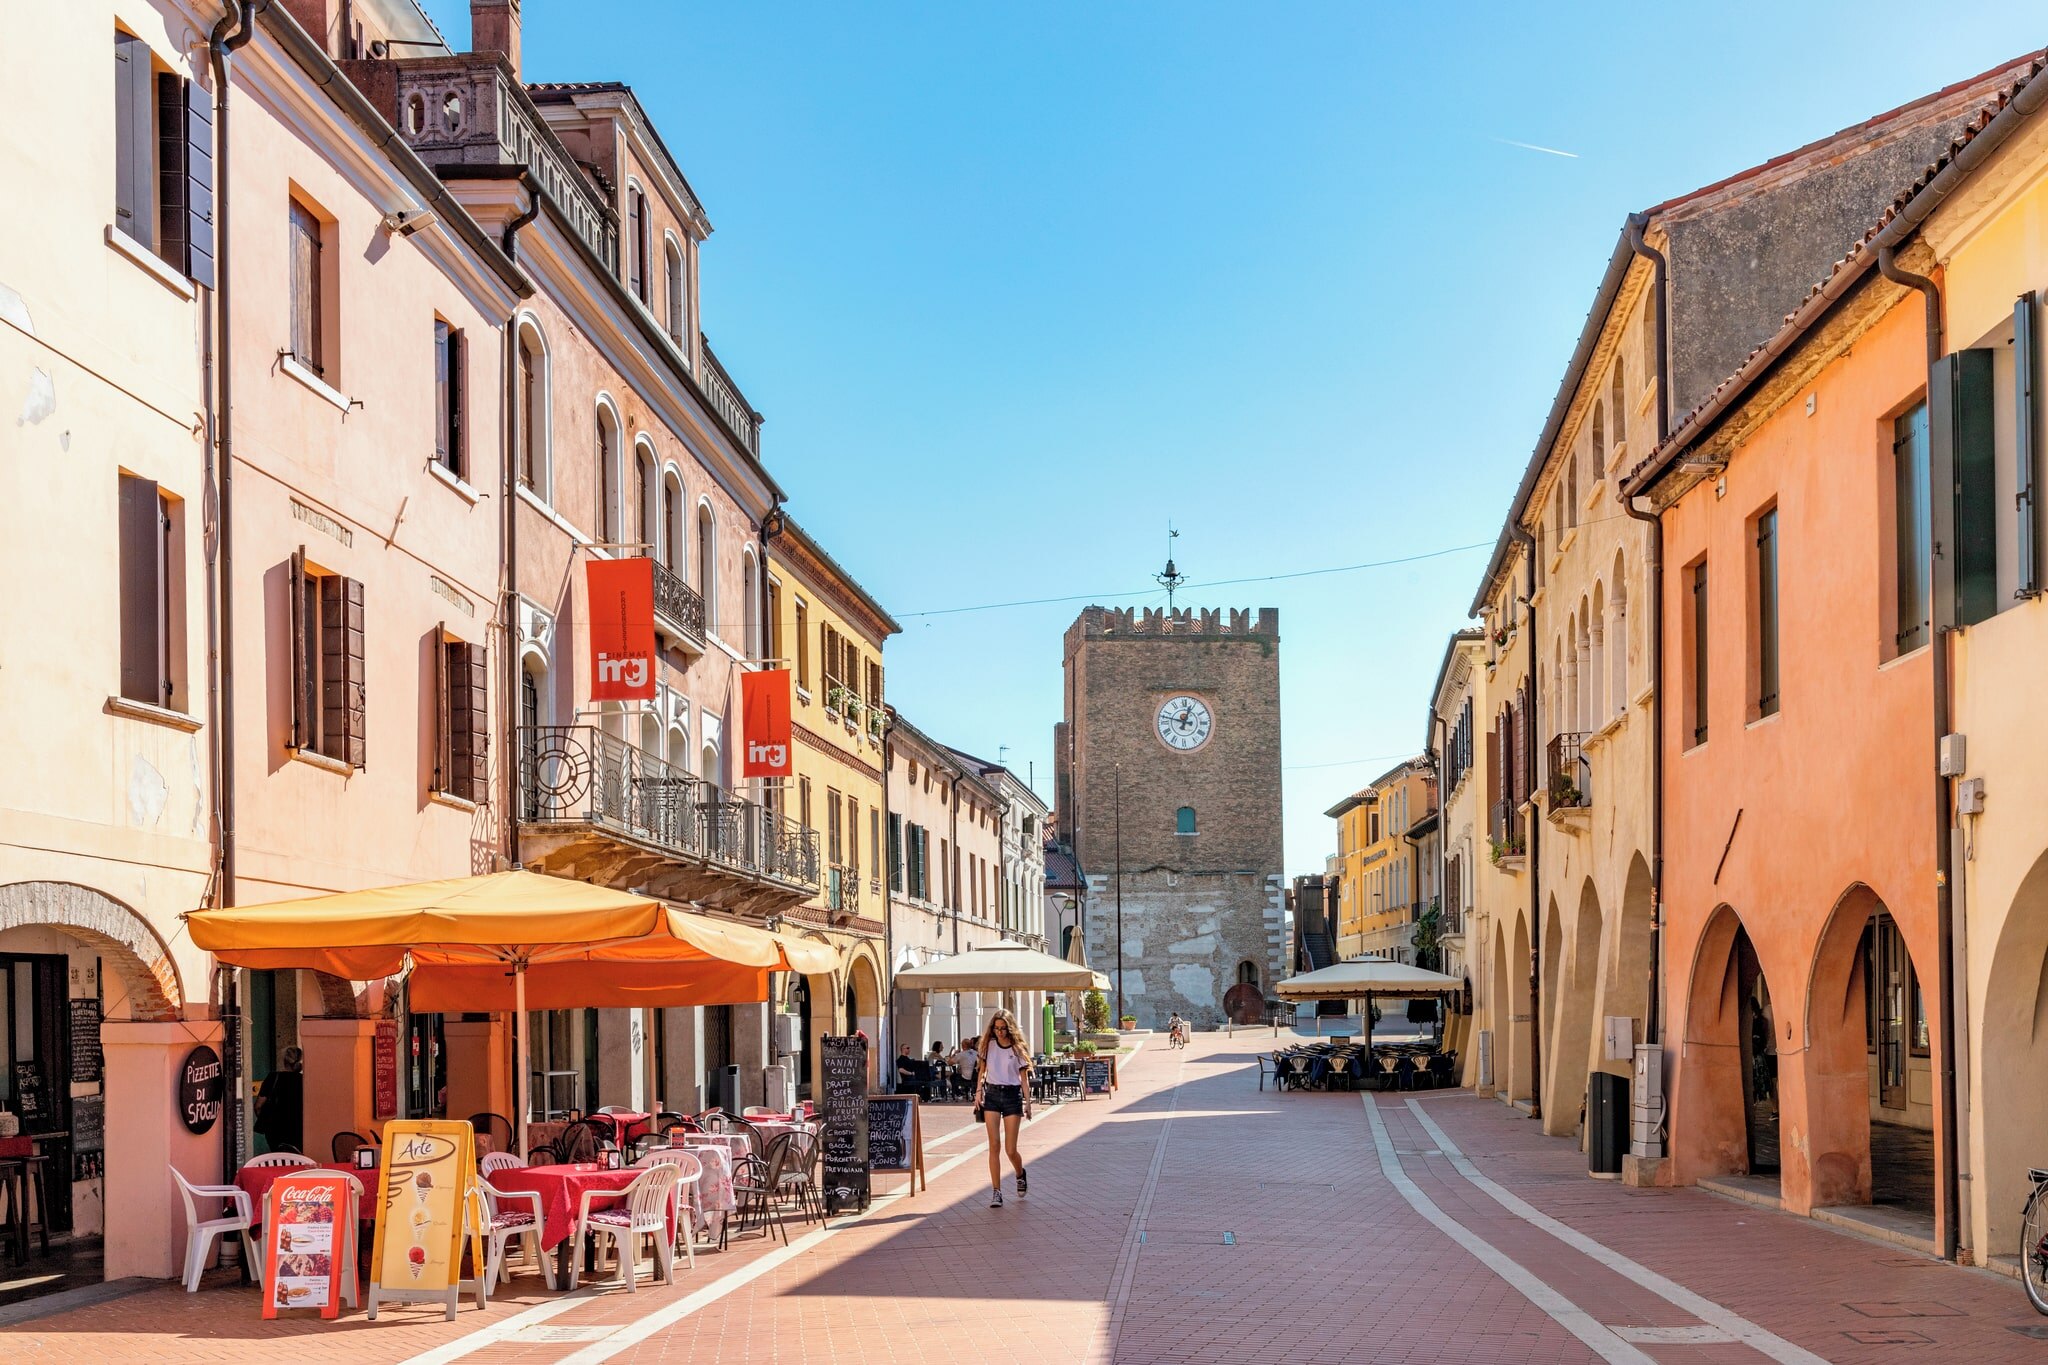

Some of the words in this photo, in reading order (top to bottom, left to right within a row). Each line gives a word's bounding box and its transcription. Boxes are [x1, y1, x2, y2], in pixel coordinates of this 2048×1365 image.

[606, 651, 648, 659] CINEMAS
[825, 1059, 858, 1067] PANINI
[825, 1080, 851, 1090] DRAFT
[196, 1088, 206, 1101] DI
[833, 1088, 852, 1097] BEER
[826, 1100, 865, 1108] FRULLATO
[869, 1102, 900, 1112] ANINI
[828, 1114, 857, 1122] FRESCA
[868, 1112, 886, 1121] ALDI
[868, 1130, 901, 1141] ANGRIA
[398, 1137, 432, 1161] Arte
[825, 1153, 862, 1162] PORCHETTA
[281, 1185, 335, 1202] Coca-Cola
